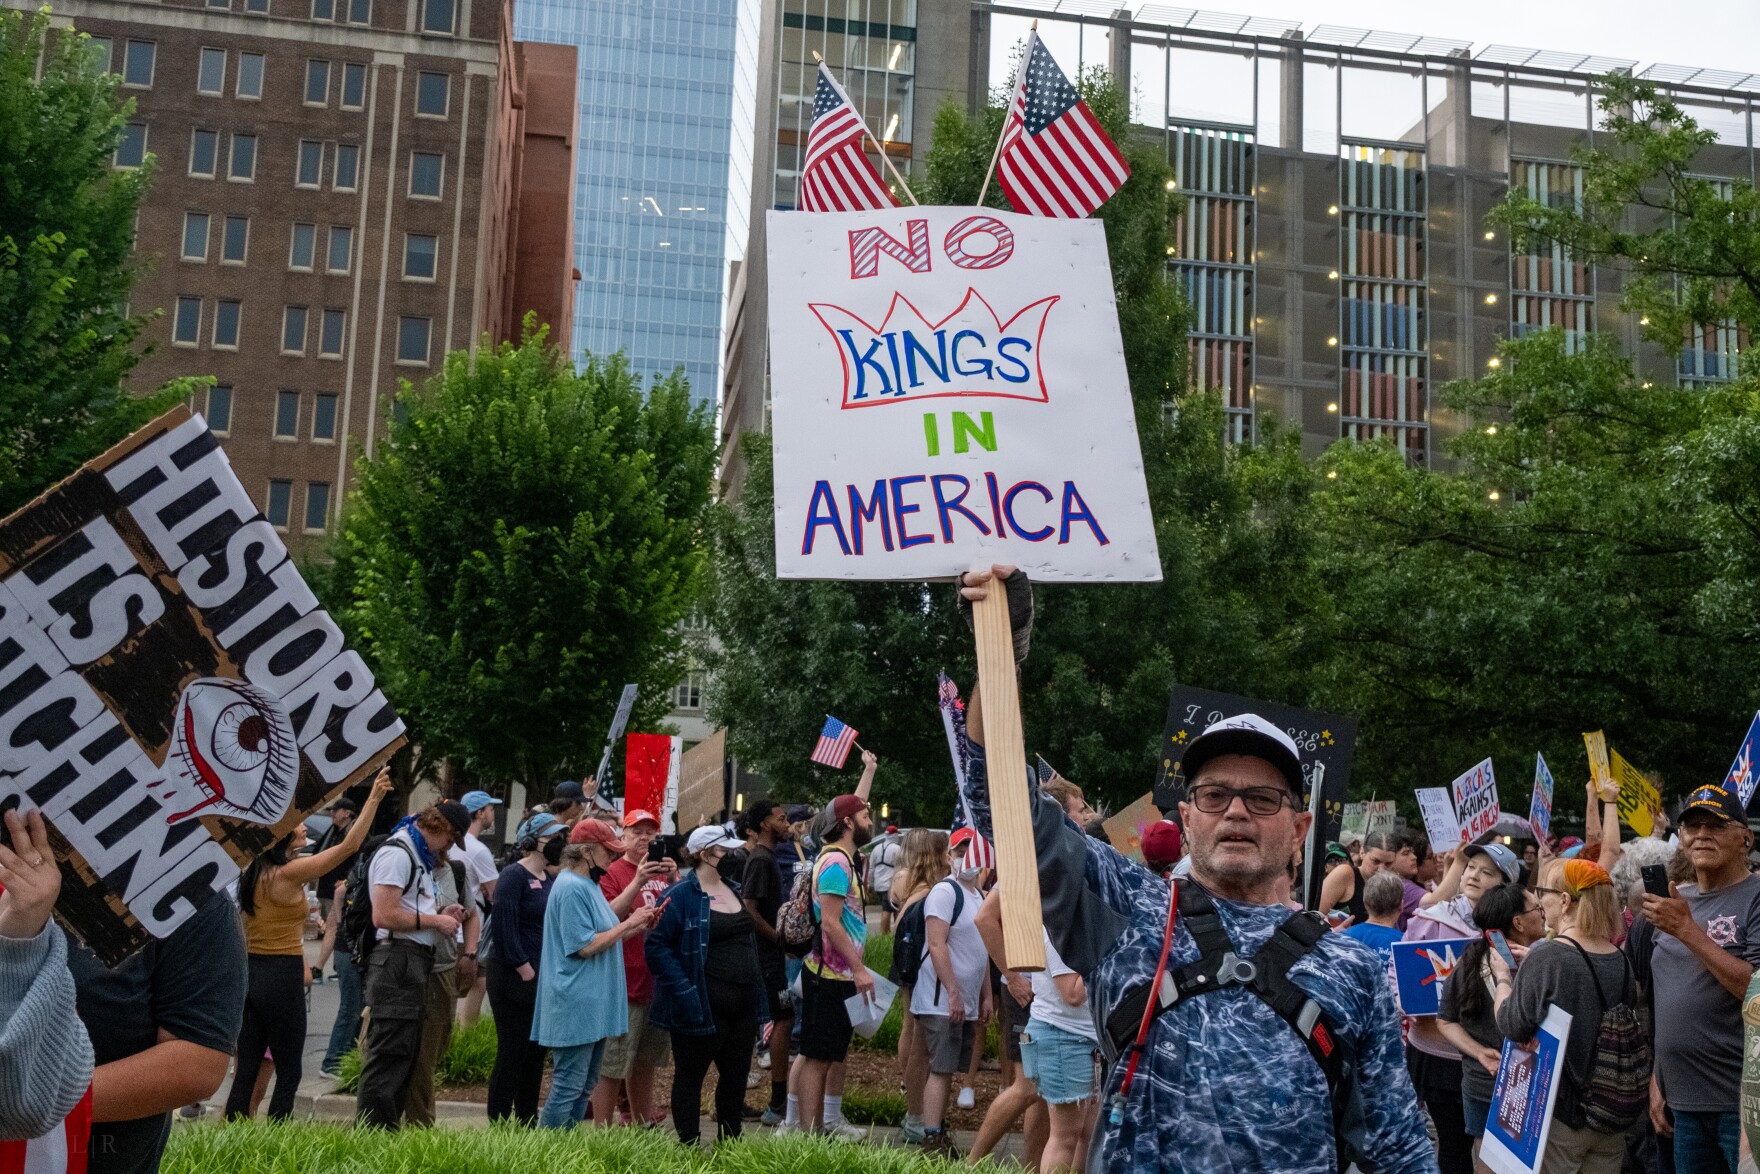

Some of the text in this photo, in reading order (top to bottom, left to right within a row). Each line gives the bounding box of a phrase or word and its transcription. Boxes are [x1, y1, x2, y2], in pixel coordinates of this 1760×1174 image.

[848, 216, 1015, 279] NO
[837, 329, 1032, 400] KINGS
[923, 411, 998, 457] IN
[801, 472, 1110, 555] AMERICA
[4, 515, 167, 666] IS
[104, 413, 406, 784] HISTORY
[0, 580, 242, 938] TCHING
[1699, 784, 1729, 797] MARINE
[1459, 783, 1494, 826] AGAINST
[1690, 800, 1723, 809] DIVISION
